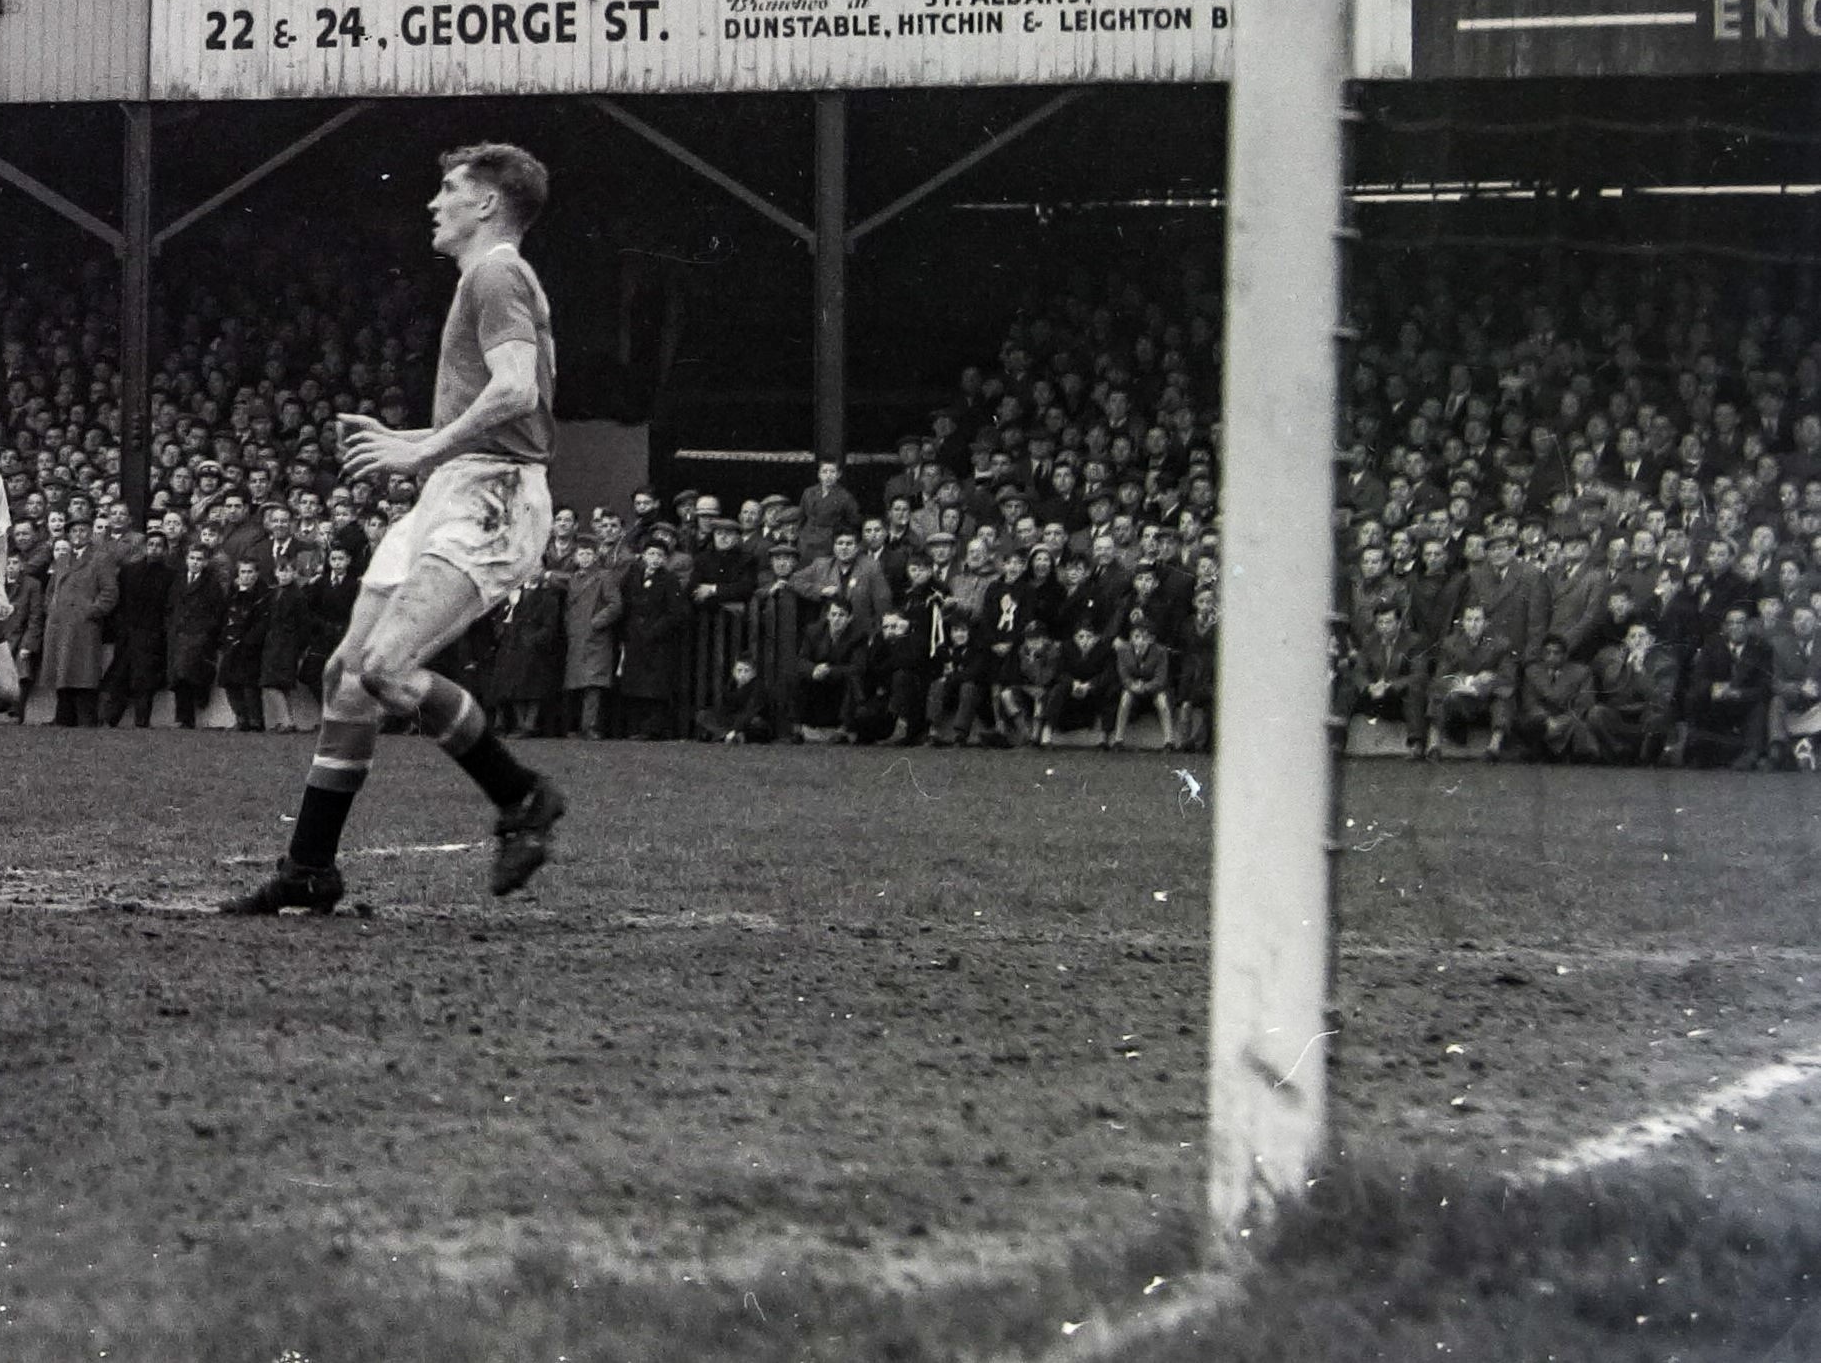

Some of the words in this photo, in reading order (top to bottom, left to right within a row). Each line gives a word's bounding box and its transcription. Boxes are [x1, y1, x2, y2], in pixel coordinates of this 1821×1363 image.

[205, 10, 256, 52] 22
[273, 18, 297, 50] &
[400, 0, 578, 48] GEORGE
[897, 11, 1004, 35] HITCHIN
[1022, 10, 1043, 34] &
[1059, 7, 1193, 33] LEIGHTON
